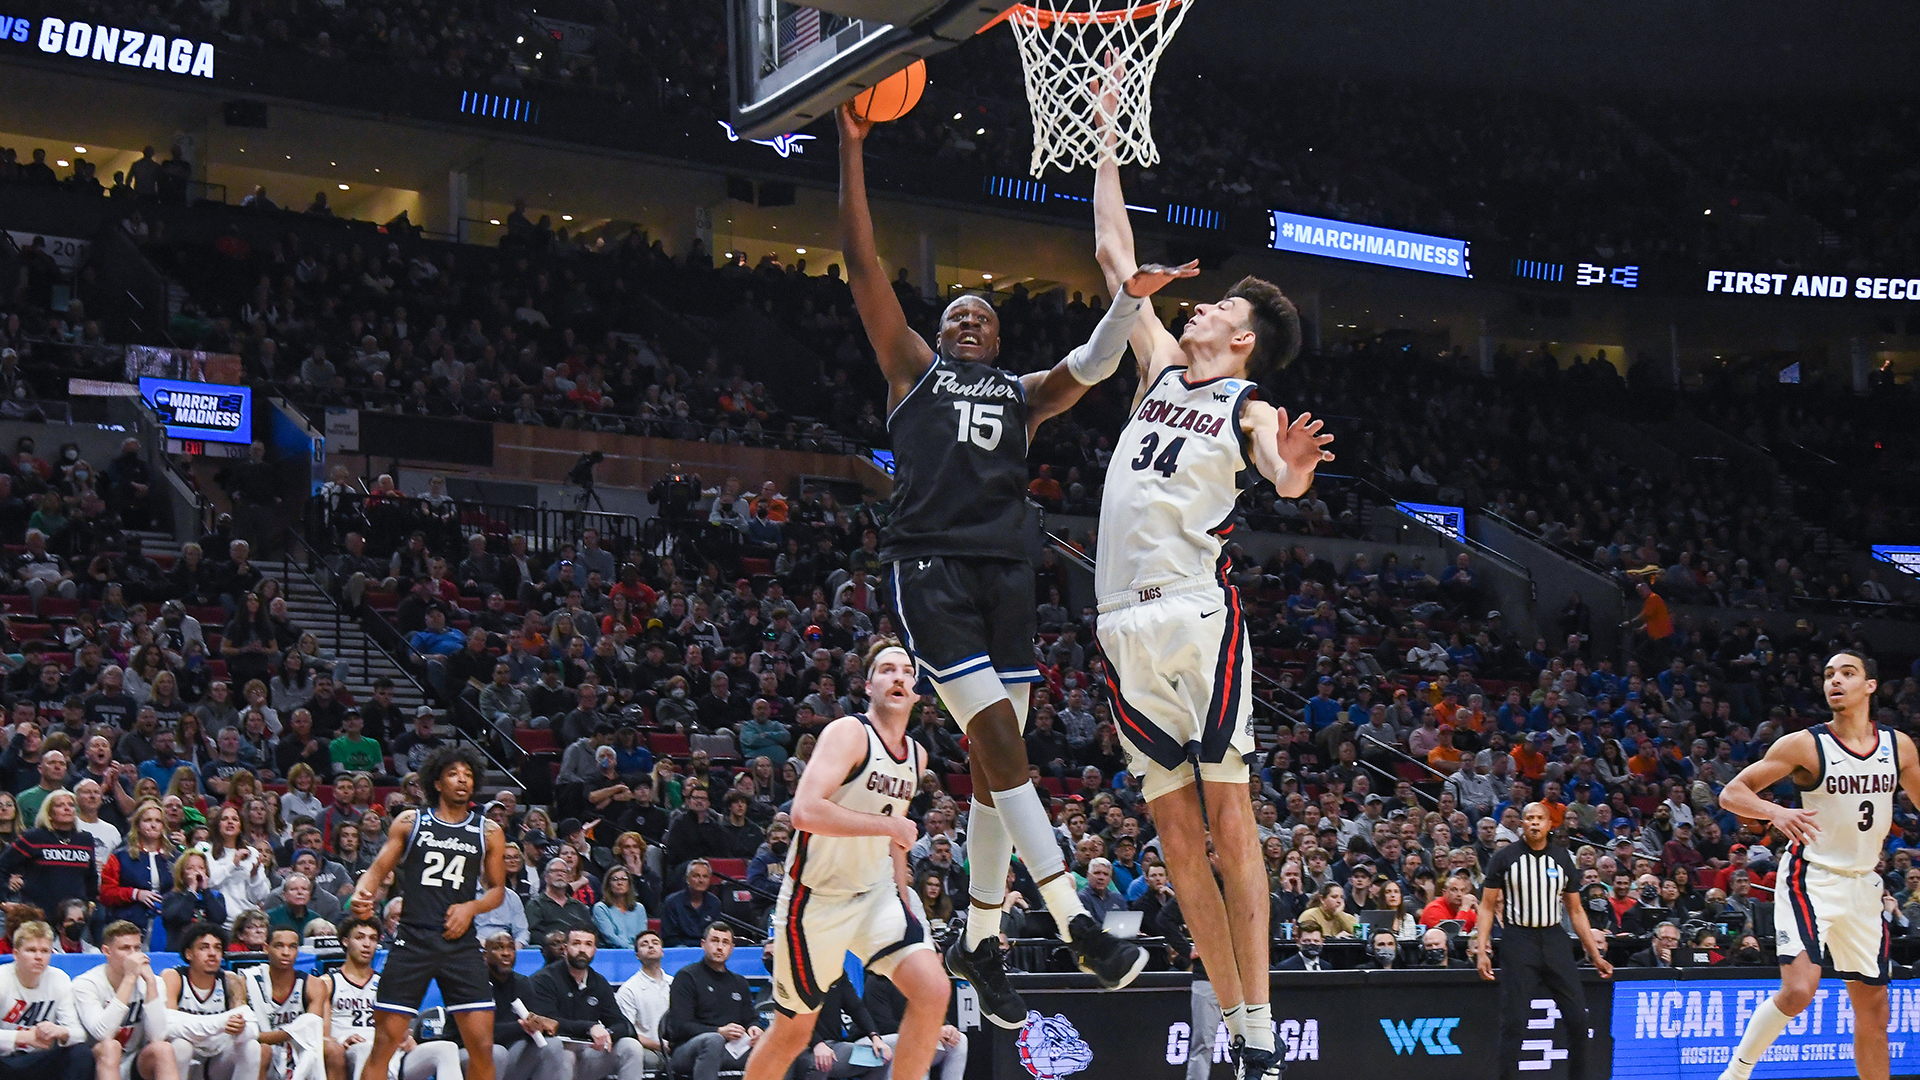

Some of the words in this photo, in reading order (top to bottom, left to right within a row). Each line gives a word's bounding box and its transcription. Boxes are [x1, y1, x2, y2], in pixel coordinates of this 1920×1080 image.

[38, 17, 215, 79] GONZAGA
[1282, 222, 1460, 267] #MARCHMADNESS
[1707, 270, 1788, 295] FIRST
[1791, 275, 1848, 298] AND
[1854, 277, 1920, 301] SECO
[169, 392, 219, 411] MARCH
[931, 369, 1020, 404] Panther
[175, 407, 241, 427] MADNESS
[953, 400, 1004, 451] 15
[1137, 398, 1227, 438] GONZAGA
[185, 440, 203, 455] EXIT
[1131, 431, 1187, 478] 34
[1138, 586, 1162, 602] ZAGS
[1857, 800, 1875, 832] 3
[42, 848, 91, 862] GONZAGA
[416, 831, 479, 854] Panthers
[420, 851, 467, 890] 24
[2, 998, 55, 1026] BALL
[352, 1010, 375, 1027] 22
[1635, 990, 1724, 1039] NCAA
[1735, 989, 1828, 1036] FST
[1836, 988, 1920, 1034] RUN
[1379, 1017, 1463, 1056] WCC
[1681, 1045, 1730, 1064] HOSTED
[1759, 1044, 1799, 1062] REGON
[1801, 1043, 1837, 1061] STATE
